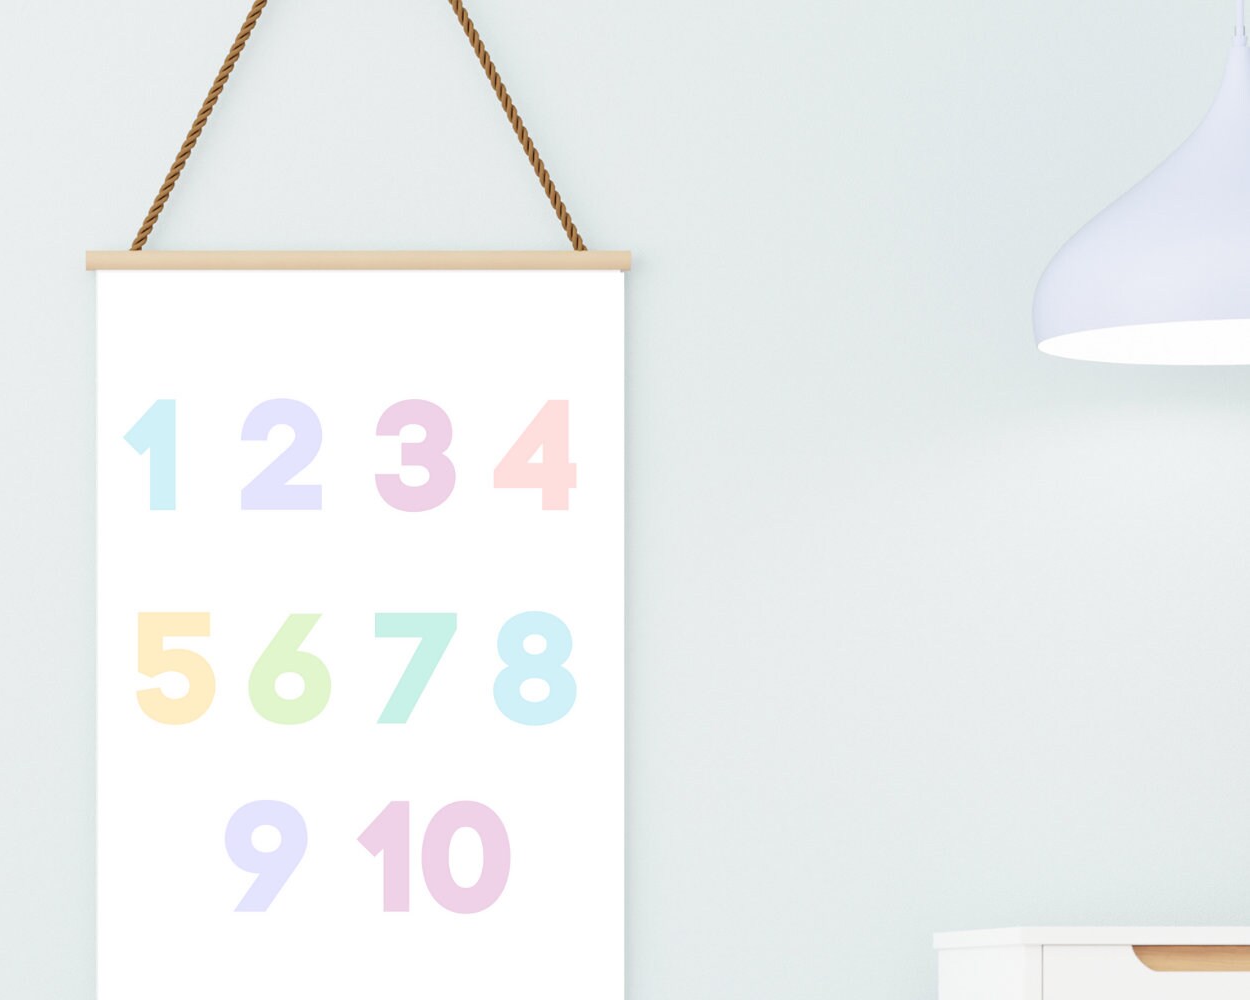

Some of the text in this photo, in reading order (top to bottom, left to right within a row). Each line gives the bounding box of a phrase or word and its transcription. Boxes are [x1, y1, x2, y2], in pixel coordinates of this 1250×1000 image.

[122, 398, 577, 512] 1 2 3 4
[134, 611, 577, 726] 5 6 7 8
[225, 800, 510, 914] 9 10
